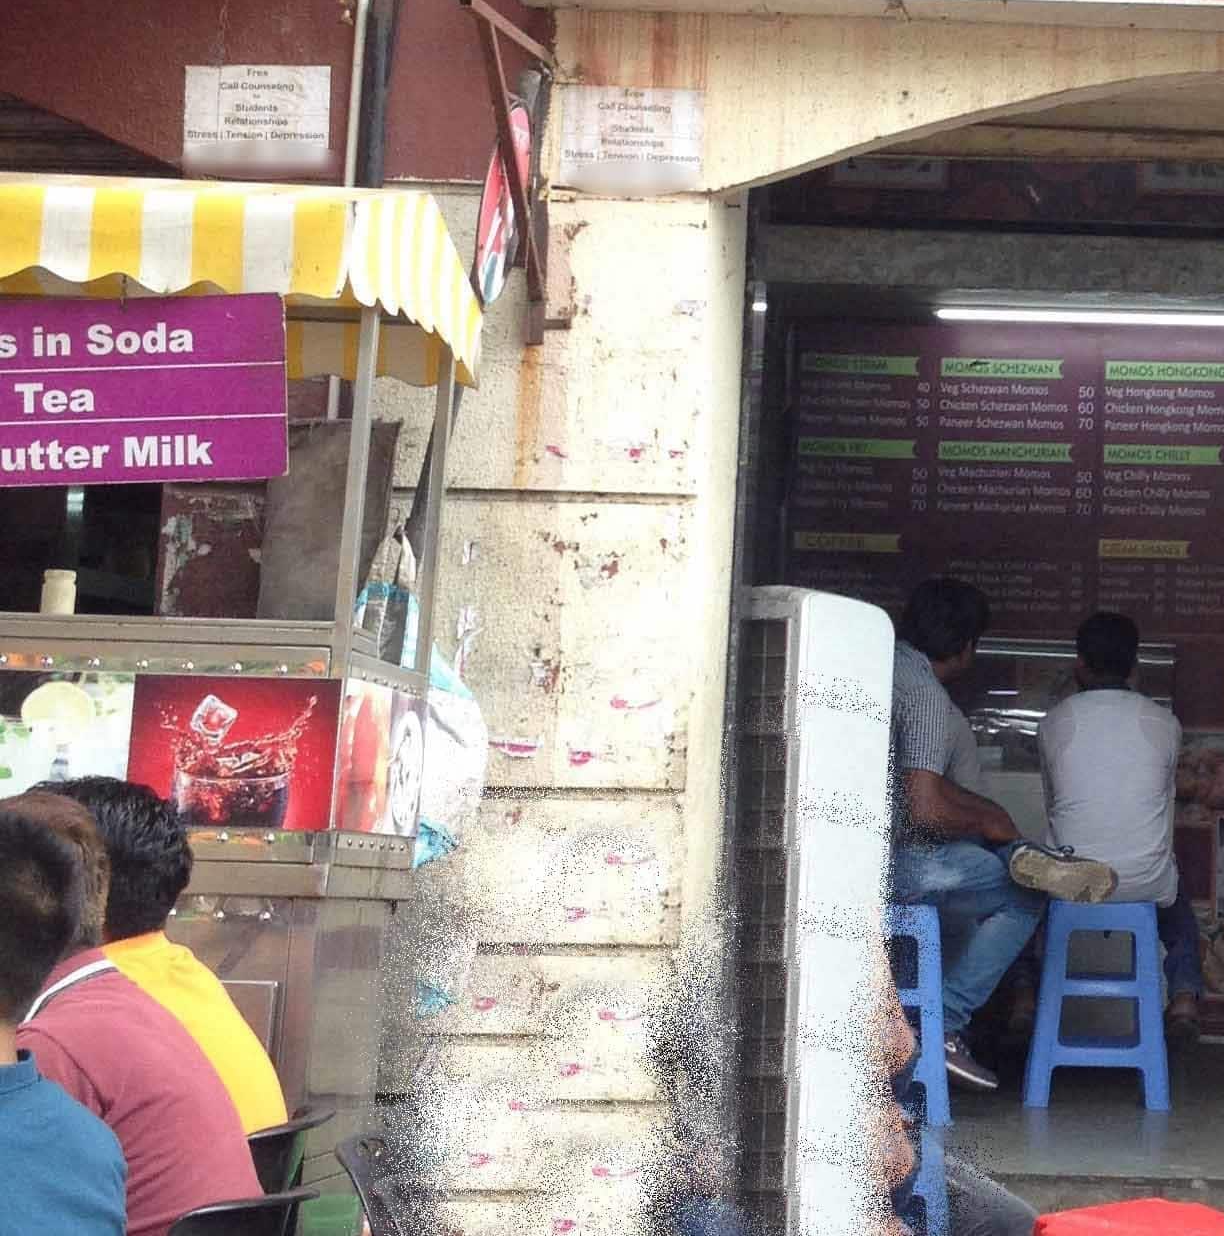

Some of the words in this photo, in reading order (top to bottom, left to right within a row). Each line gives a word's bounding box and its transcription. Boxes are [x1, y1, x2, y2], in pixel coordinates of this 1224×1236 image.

[247, 67, 268, 77] Free
[220, 82, 239, 91] Call
[234, 103, 278, 112] Students
[187, 130, 218, 139] Stress
[226, 130, 263, 139] Tension
[270, 131, 325, 140] Depression
[33, 326, 71, 357] in
[86, 322, 194, 356] Soda
[944, 361, 990, 373] MOMOS
[991, 362, 1055, 375] SCHEZWAN
[1109, 365, 1154, 377] MOMOS
[940, 381, 960, 396] Veg
[960, 382, 1010, 396] Schezwan
[1011, 383, 1049, 396] Momos
[1078, 386, 1095, 399] 50
[1104, 386, 1124, 399] Veg
[1177, 388, 1216, 400] Momos
[14, 382, 96, 414] Tea
[939, 399, 979, 412] Chicken
[980, 399, 1029, 413] Schezwan
[1031, 401, 1068, 413] Momos
[1077, 402, 1095, 415] 60
[1104, 402, 1144, 414] Chicken
[939, 416, 974, 429] Paneer
[975, 416, 1025, 430] Schezwan
[1027, 418, 1065, 431] Momos
[1078, 418, 1095, 431] 70
[1104, 419, 1139, 432] Paneer
[0, 439, 111, 471] utter
[123, 434, 214, 467] Milk
[942, 445, 988, 457] MOMOS
[1107, 448, 1153, 460] MOMOS
[1075, 487, 1092, 499] 60
